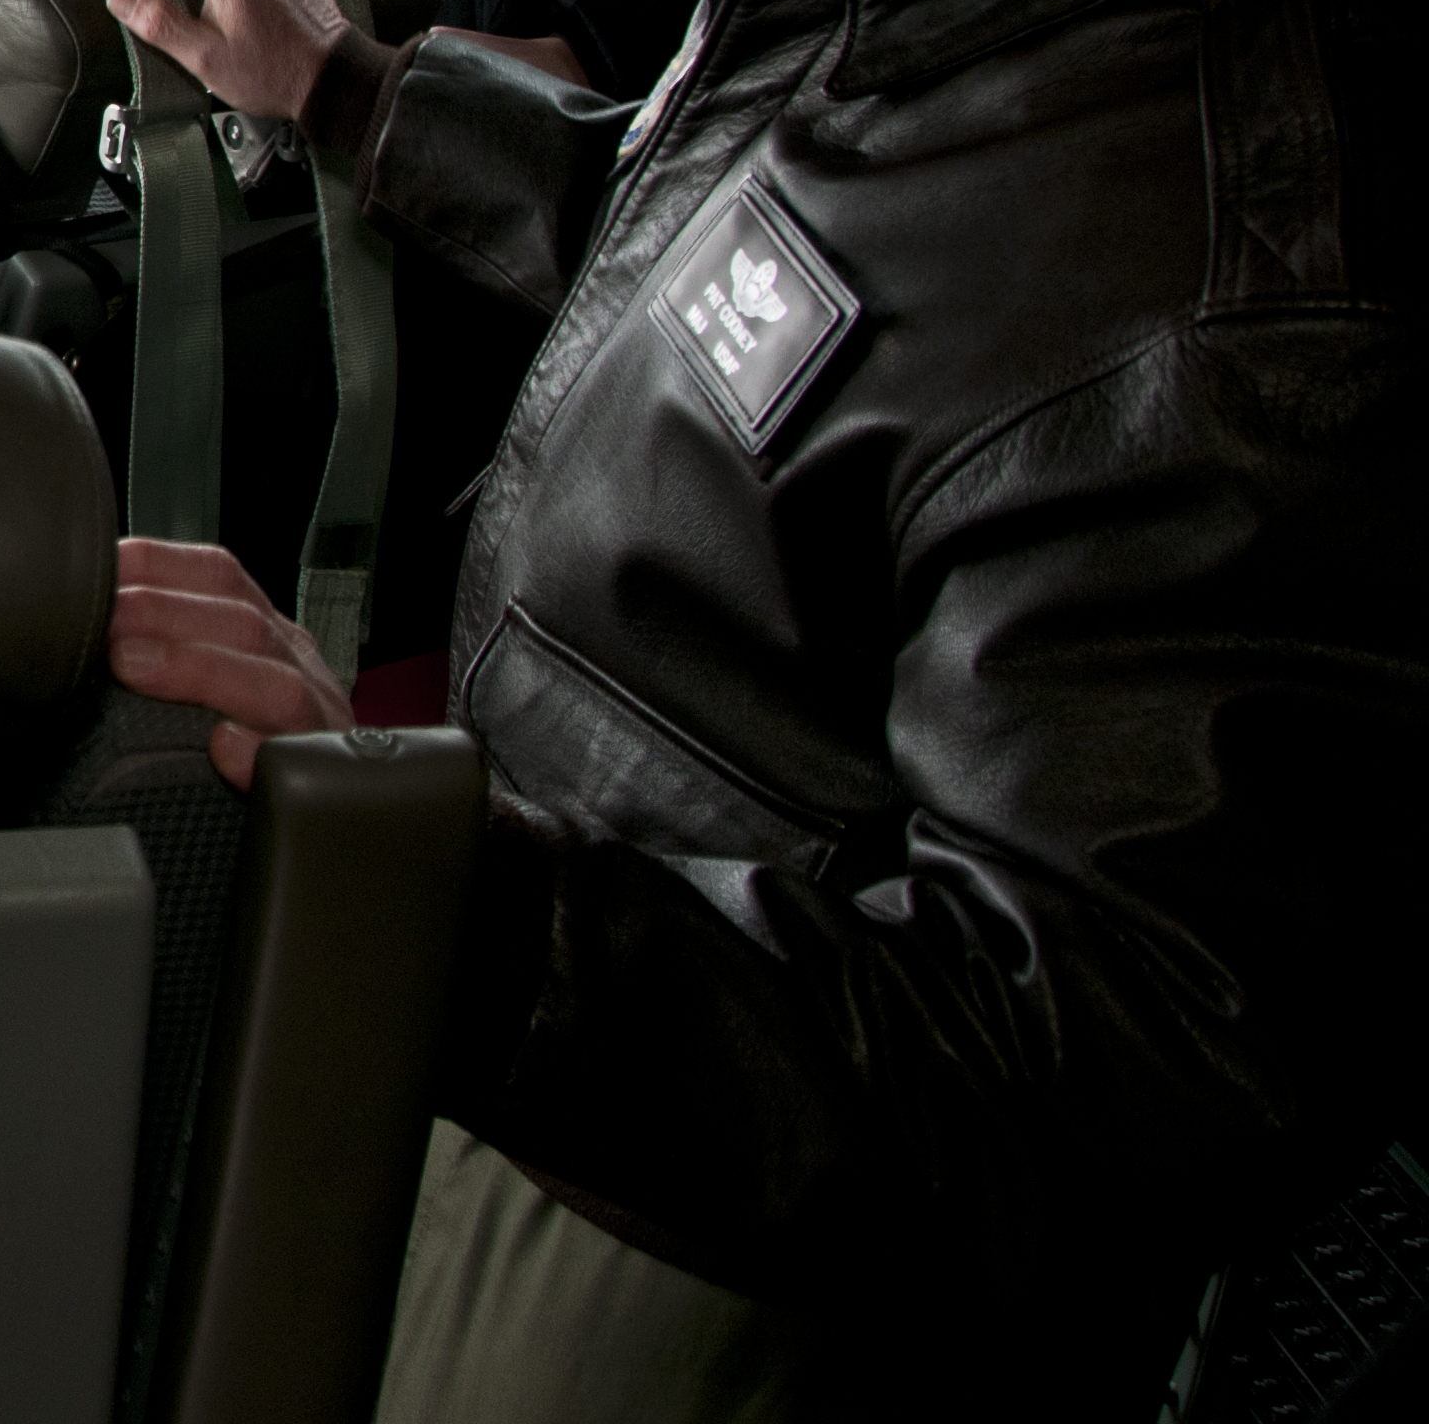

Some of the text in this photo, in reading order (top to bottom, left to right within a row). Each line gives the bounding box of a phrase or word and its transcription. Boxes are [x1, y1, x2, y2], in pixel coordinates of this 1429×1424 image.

[703, 281, 758, 354] PAT COONEY
[712, 340, 741, 376] USAF
